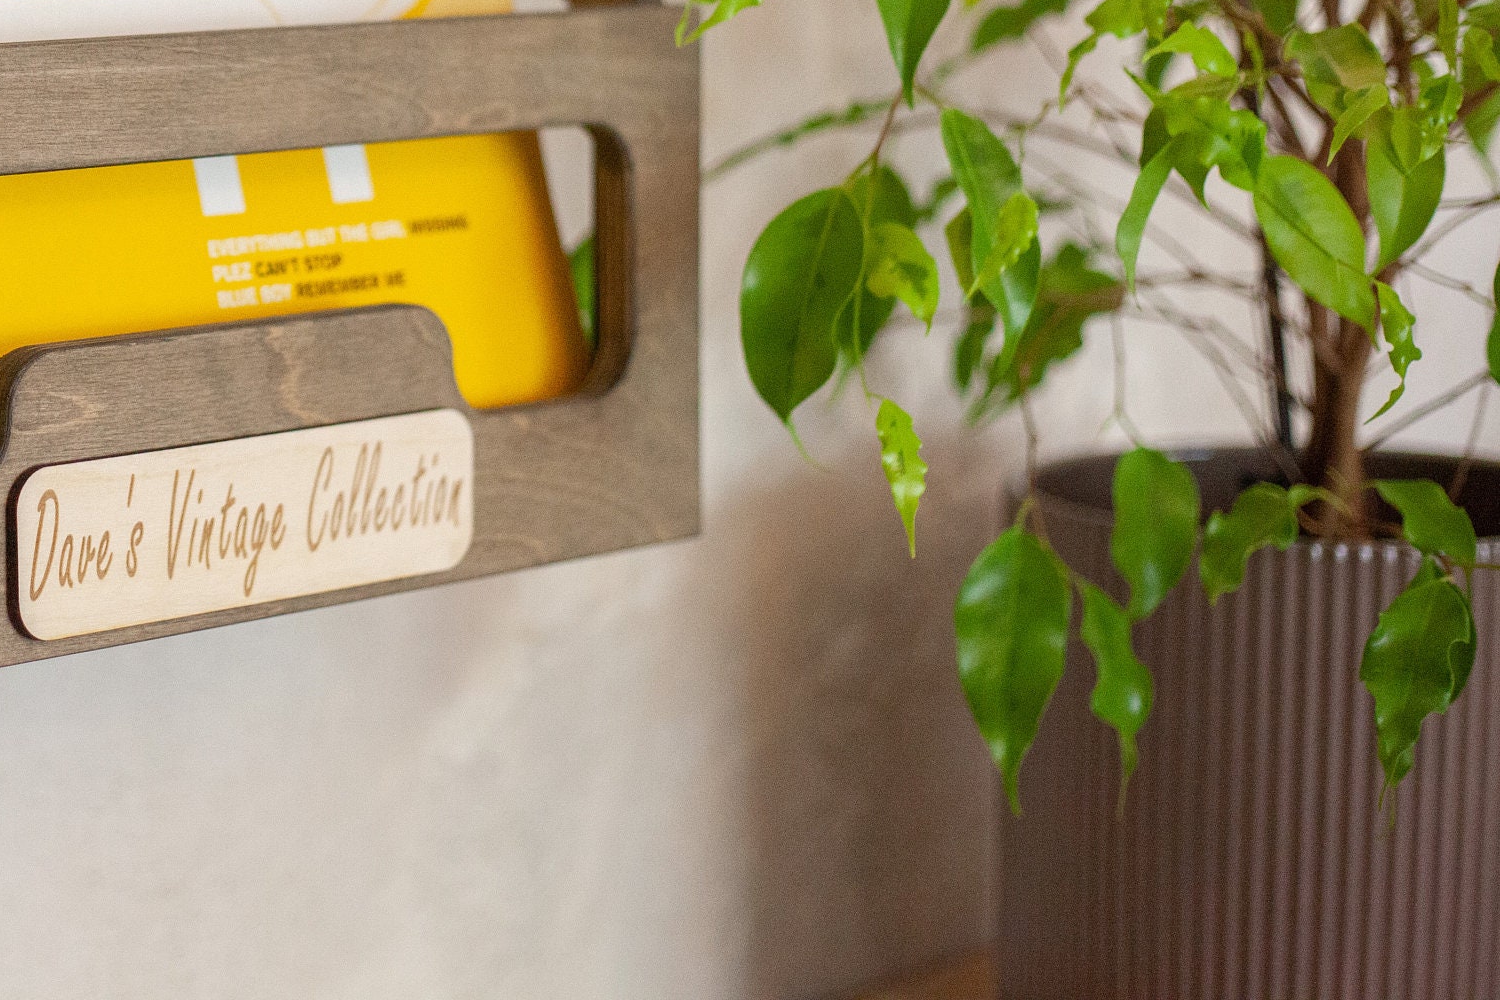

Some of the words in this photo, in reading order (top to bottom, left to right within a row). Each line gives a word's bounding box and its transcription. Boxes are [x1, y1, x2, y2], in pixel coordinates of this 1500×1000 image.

[207, 230, 303, 259] EVERYTHING
[305, 226, 336, 248] BUT
[339, 222, 367, 243] THE
[255, 257, 299, 278] CAN'T
[304, 253, 342, 272] STOP
[216, 286, 258, 308] BLUE
[260, 283, 292, 304] BOY
[297, 274, 380, 298] REMEMBER
[29, 474, 145, 602] Dave's
[167, 469, 286, 598] Vintage
[307, 441, 466, 553] Collection
